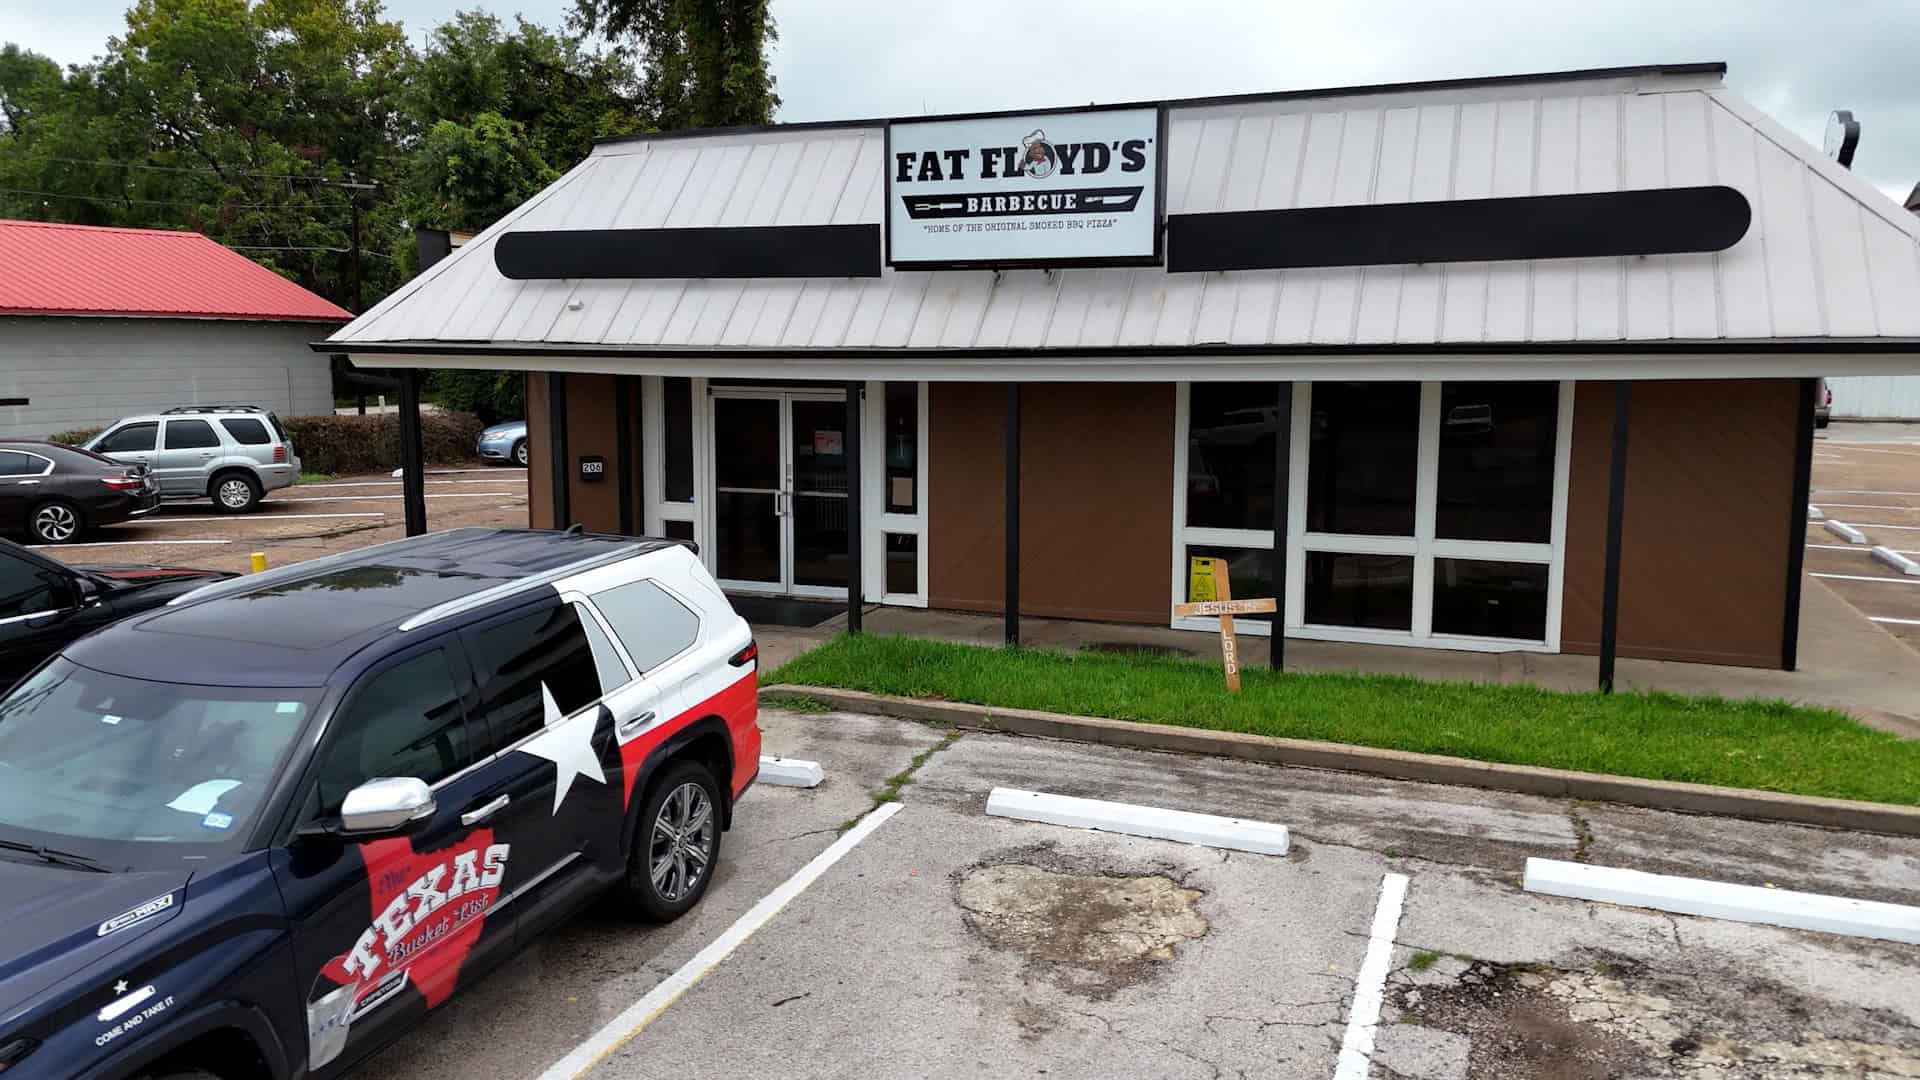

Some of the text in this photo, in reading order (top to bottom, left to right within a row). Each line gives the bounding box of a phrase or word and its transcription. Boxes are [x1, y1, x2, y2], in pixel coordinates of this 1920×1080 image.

[896, 148, 970, 183] FAT
[967, 194, 1077, 213] BARBECUE
[952, 223, 963, 233] OF
[966, 223, 983, 232] THE
[985, 222, 1027, 232] ORIGINAL
[1029, 220, 1064, 230] SMOKED
[1066, 219, 1084, 229] BBQ
[583, 463, 601, 472] 206
[1194, 601, 1239, 615] JESUS
[1223, 628, 1236, 674] LORD
[341, 843, 511, 981] TEXAS
[386, 892, 490, 967] Bucket List
[95, 996, 174, 1046] COME AND TAKE IT
